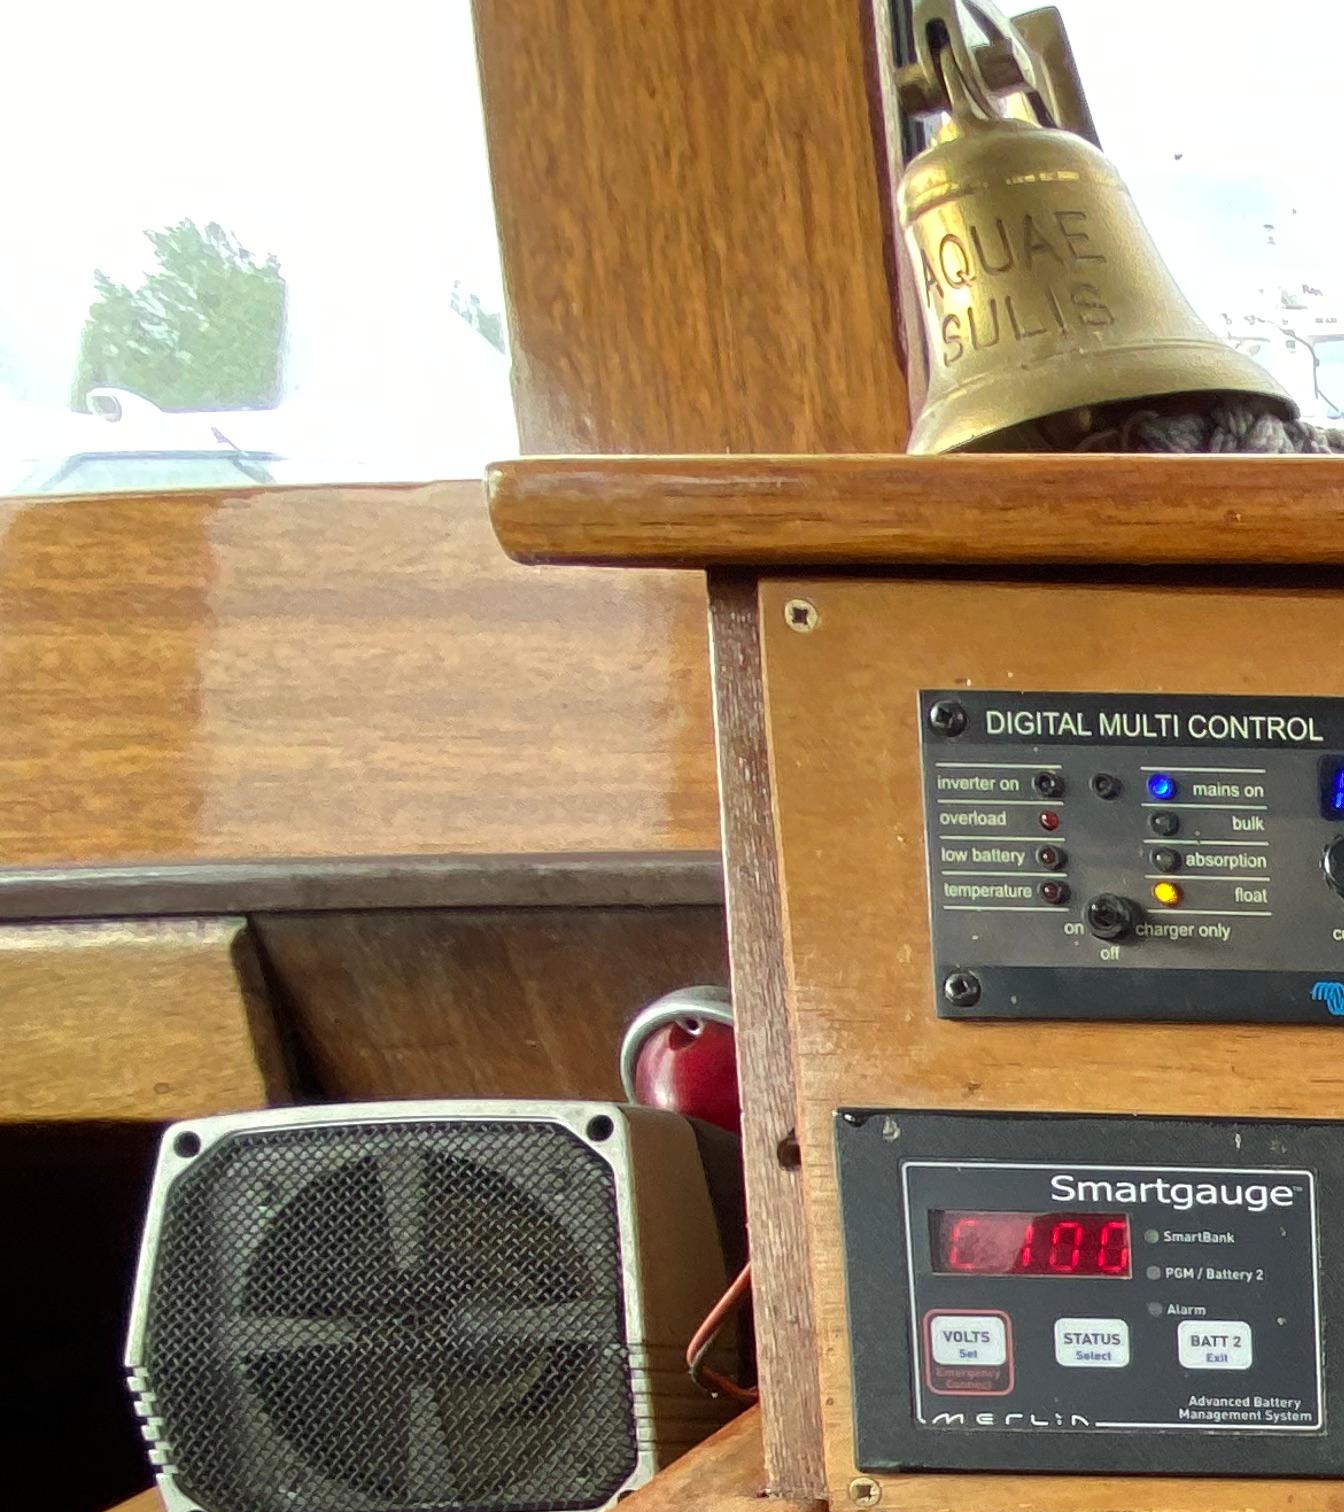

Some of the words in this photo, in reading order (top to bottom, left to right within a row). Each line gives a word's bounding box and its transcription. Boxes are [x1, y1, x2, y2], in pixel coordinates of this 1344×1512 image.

[920, 211, 1107, 309] AQUAE
[942, 284, 1115, 367] SULIS
[986, 710, 1092, 736] DIGITAL
[1100, 713, 1180, 739] MULTI
[1188, 715, 1324, 742] CONTROL
[937, 775, 995, 792] inverter
[999, 778, 1020, 791] on
[1193, 782, 1239, 798] mains
[1244, 785, 1265, 798] on
[939, 811, 1007, 826] overload
[1232, 816, 1265, 831] bulk
[941, 847, 967, 862] low
[972, 848, 1025, 866] battery
[1186, 853, 1267, 871] absorption
[944, 882, 1032, 900] temperature
[1235, 887, 1268, 903] float
[1064, 922, 1085, 935] on
[1135, 923, 1194, 940] charger
[1198, 924, 1231, 941] only
[1100, 945, 1121, 961] off
[1051, 1174, 1294, 1213] Smartgauge
[1163, 1230, 1235, 1244] SmartBank
[1165, 1267, 1194, 1279] PGM
[1206, 1268, 1253, 1283] Battery
[1256, 1269, 1264, 1280] 2
[1167, 1303, 1207, 1316] Alarm
[943, 1330, 991, 1343] VOLTS
[1063, 1333, 1121, 1346] STATUS
[1190, 1335, 1229, 1347] BATT
[1233, 1335, 1242, 1348] 2
[1076, 1351, 1112, 1361] Select
[1206, 1353, 1228, 1363] Exit
[1188, 1395, 1250, 1407] Advanced
[1253, 1396, 1301, 1410] Battery
[1178, 1408, 1261, 1422] Management
[1265, 1409, 1312, 1422] System
